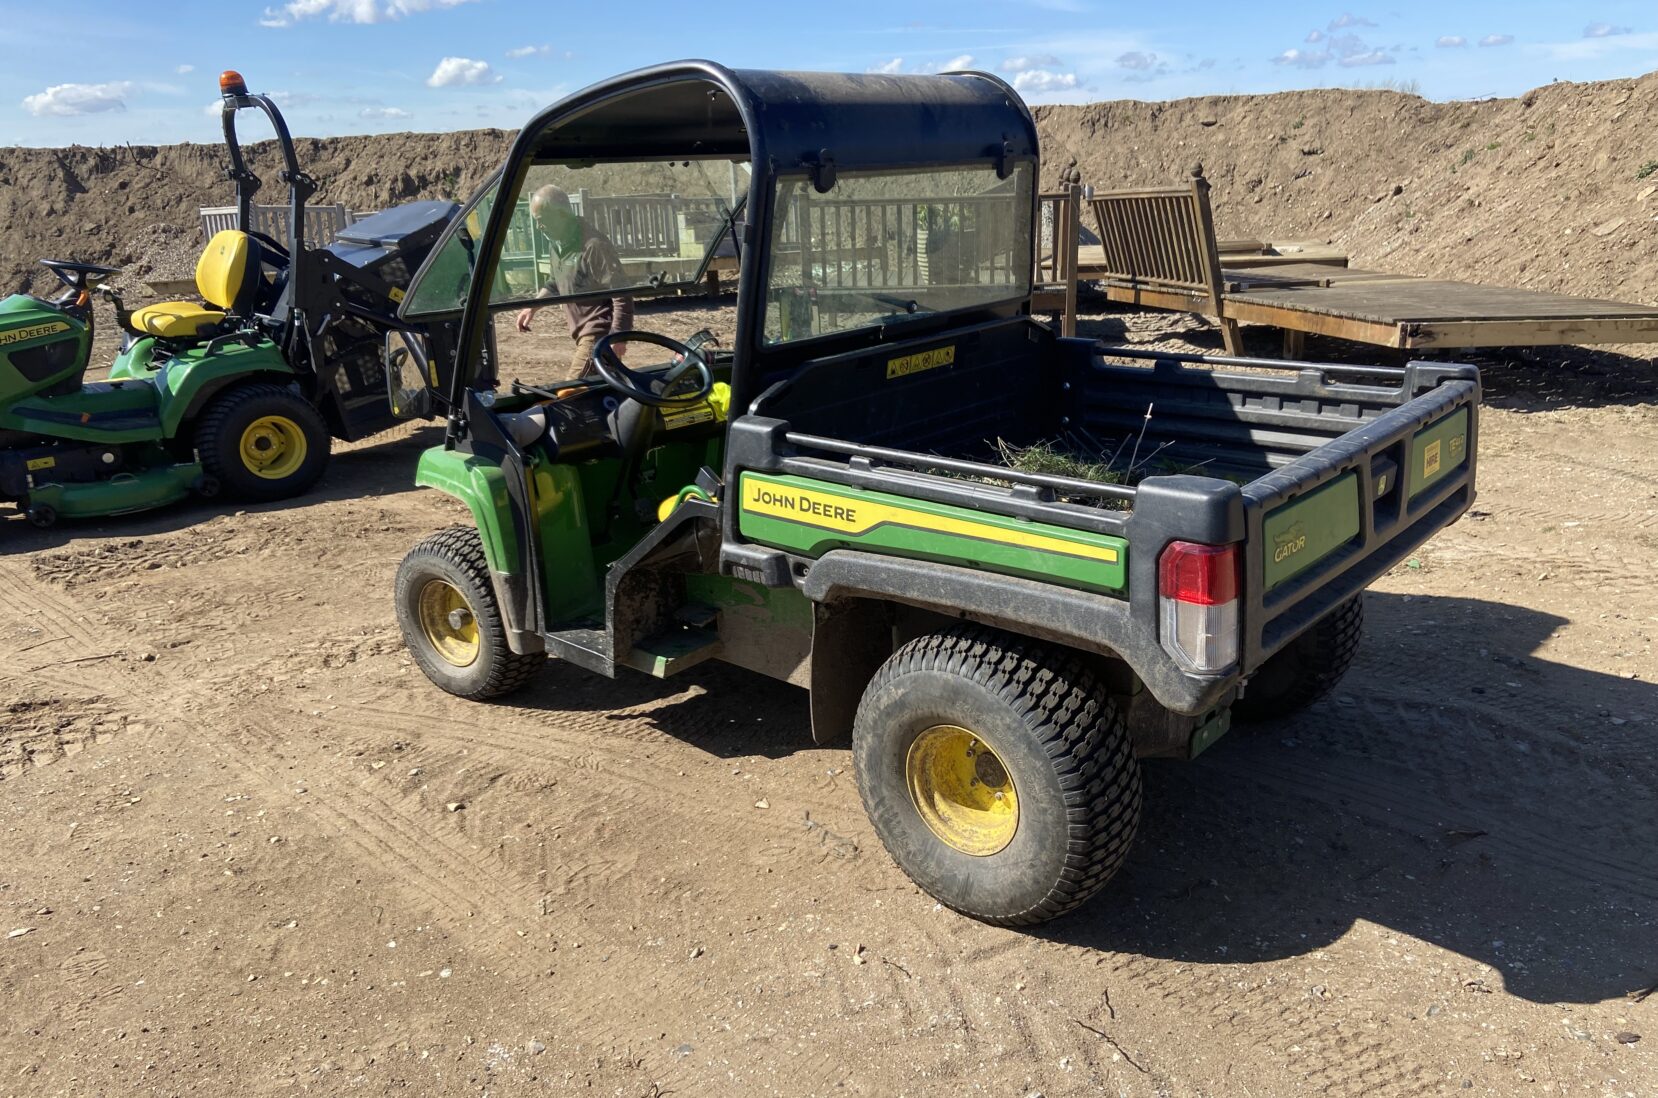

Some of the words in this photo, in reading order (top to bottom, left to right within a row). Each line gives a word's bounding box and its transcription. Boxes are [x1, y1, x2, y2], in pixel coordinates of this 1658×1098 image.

[0, 333, 17, 344] HN
[19, 324, 58, 340] DEERE
[753, 487, 795, 510] JOHN
[799, 496, 857, 523] DEERE
[1274, 535, 1306, 563] GATOR
